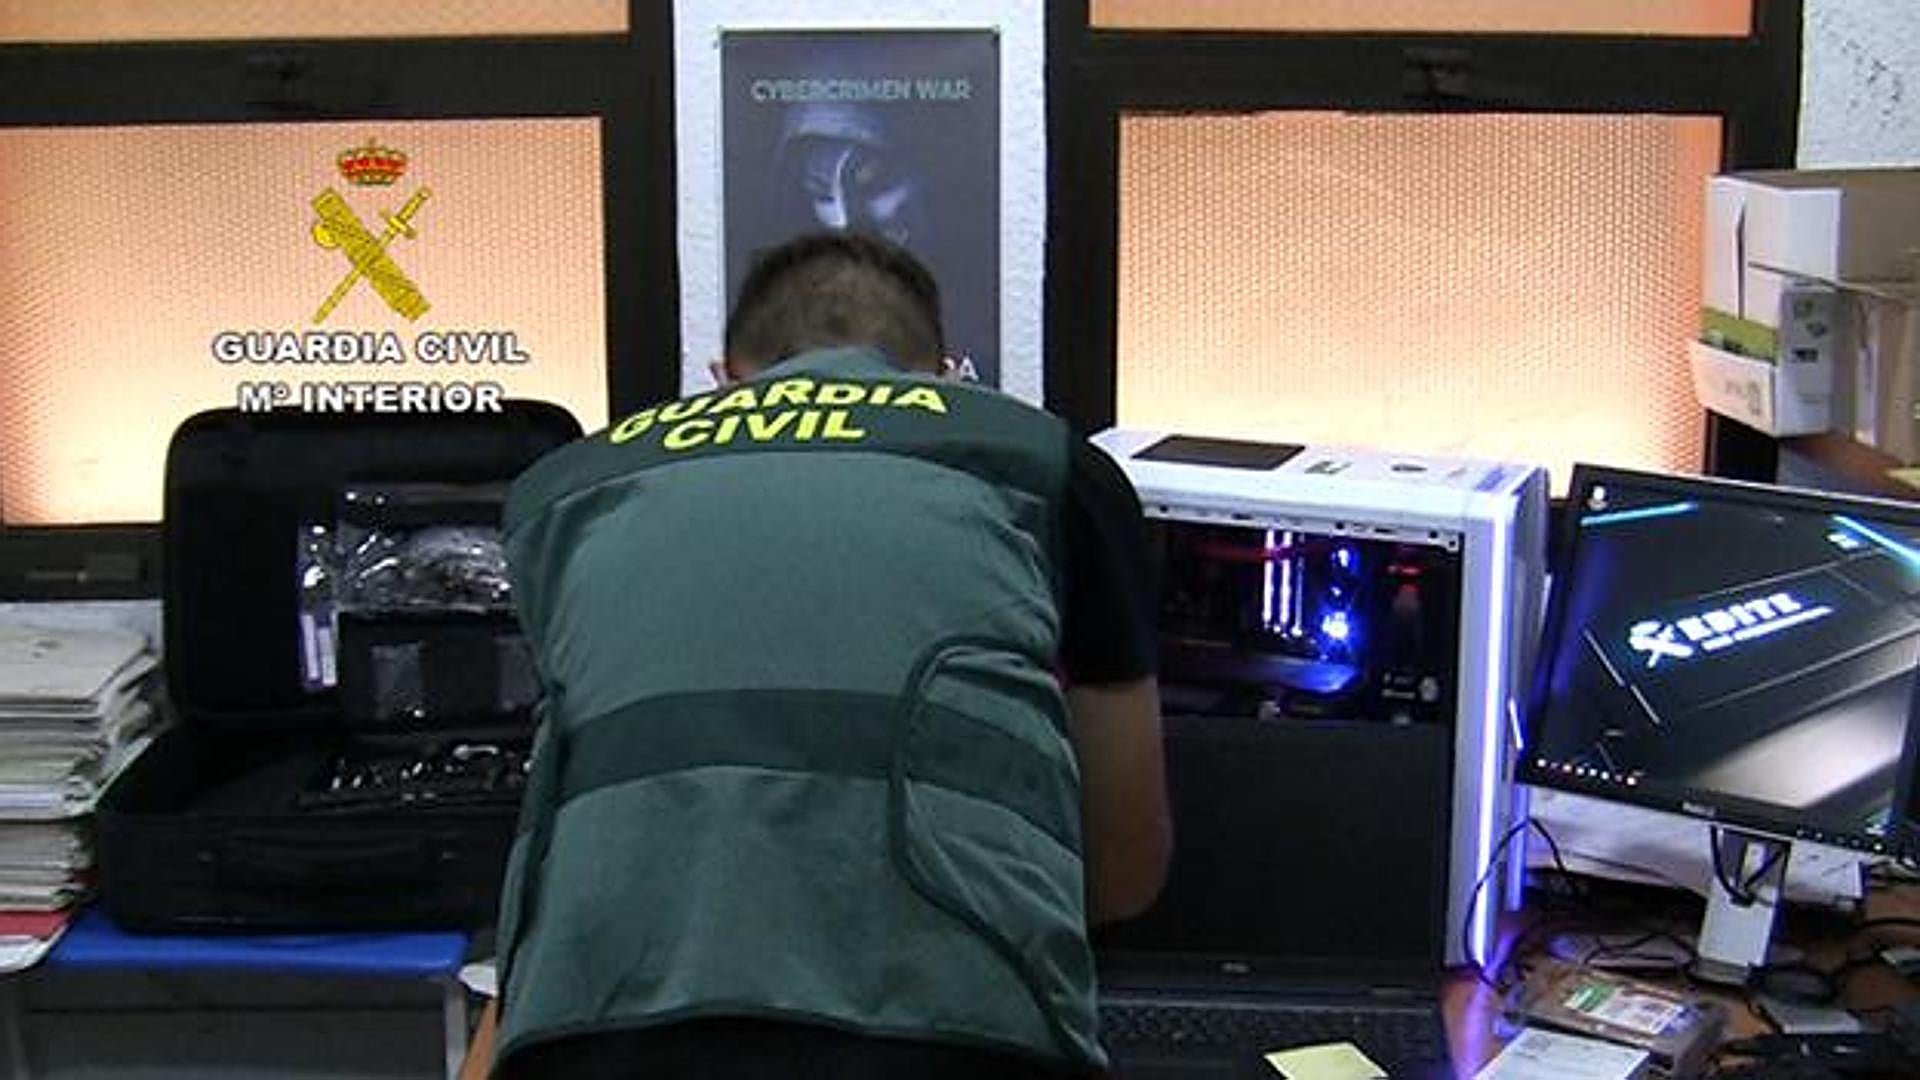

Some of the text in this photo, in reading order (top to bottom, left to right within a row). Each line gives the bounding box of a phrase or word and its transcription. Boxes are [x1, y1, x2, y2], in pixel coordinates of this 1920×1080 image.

[915, 79, 970, 99] WAR
[609, 378, 947, 443] GUARDIA
[662, 410, 867, 449] CIVIL
